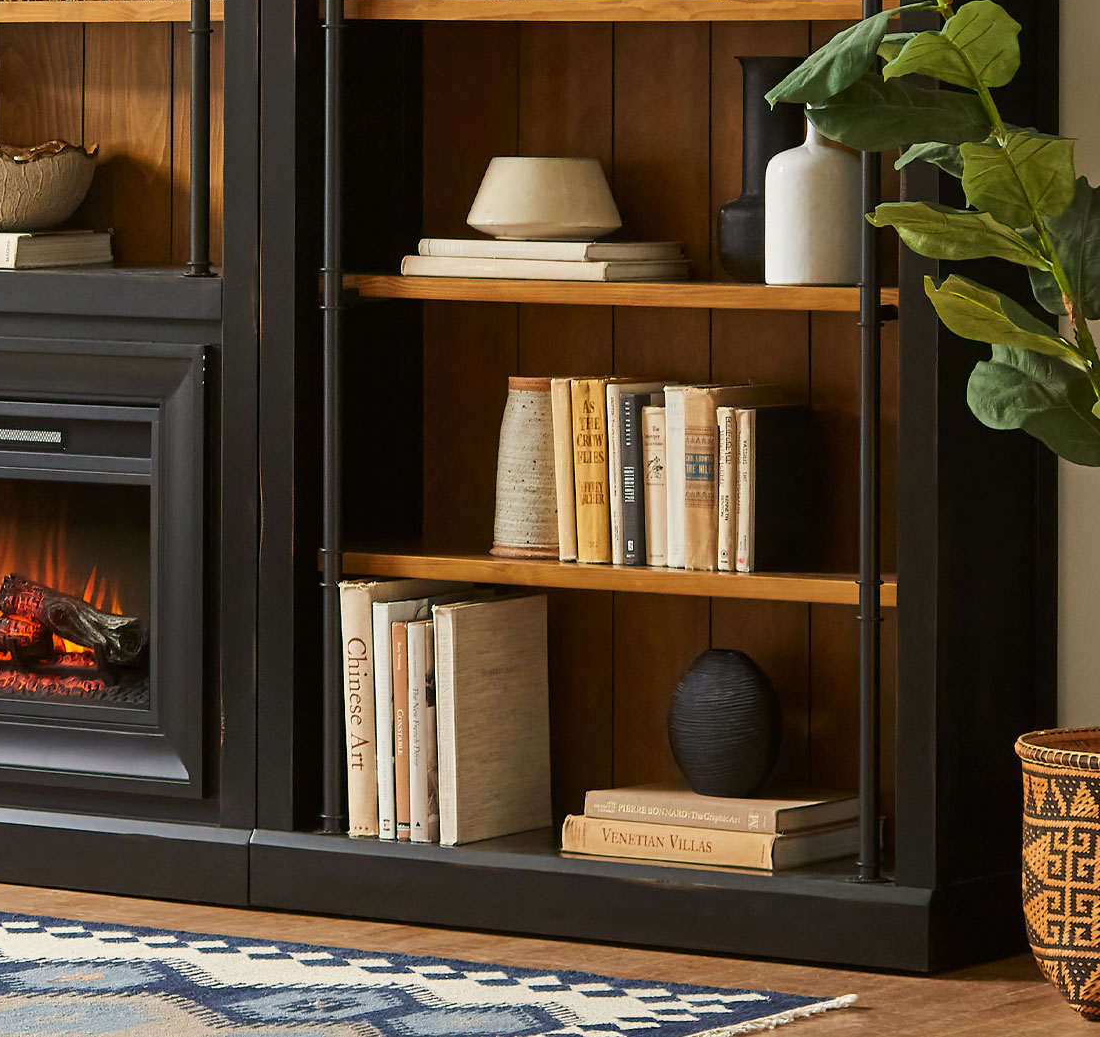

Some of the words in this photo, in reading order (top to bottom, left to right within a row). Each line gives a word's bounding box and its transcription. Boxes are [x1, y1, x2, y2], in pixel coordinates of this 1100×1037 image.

[583, 400, 595, 414] AS
[578, 417, 601, 431] THE
[576, 434, 604, 447] CROW
[577, 451, 605, 464] FLIES
[347, 636, 371, 726] Chinese
[396, 708, 405, 756] CONSTABLE
[412, 720, 420, 744] French
[350, 733, 371, 772] Art
[617, 803, 648, 815] PIERRE
[692, 811, 704, 821] The
[601, 827, 665, 848] VENETIAN
[668, 833, 713, 853] VILLAS
